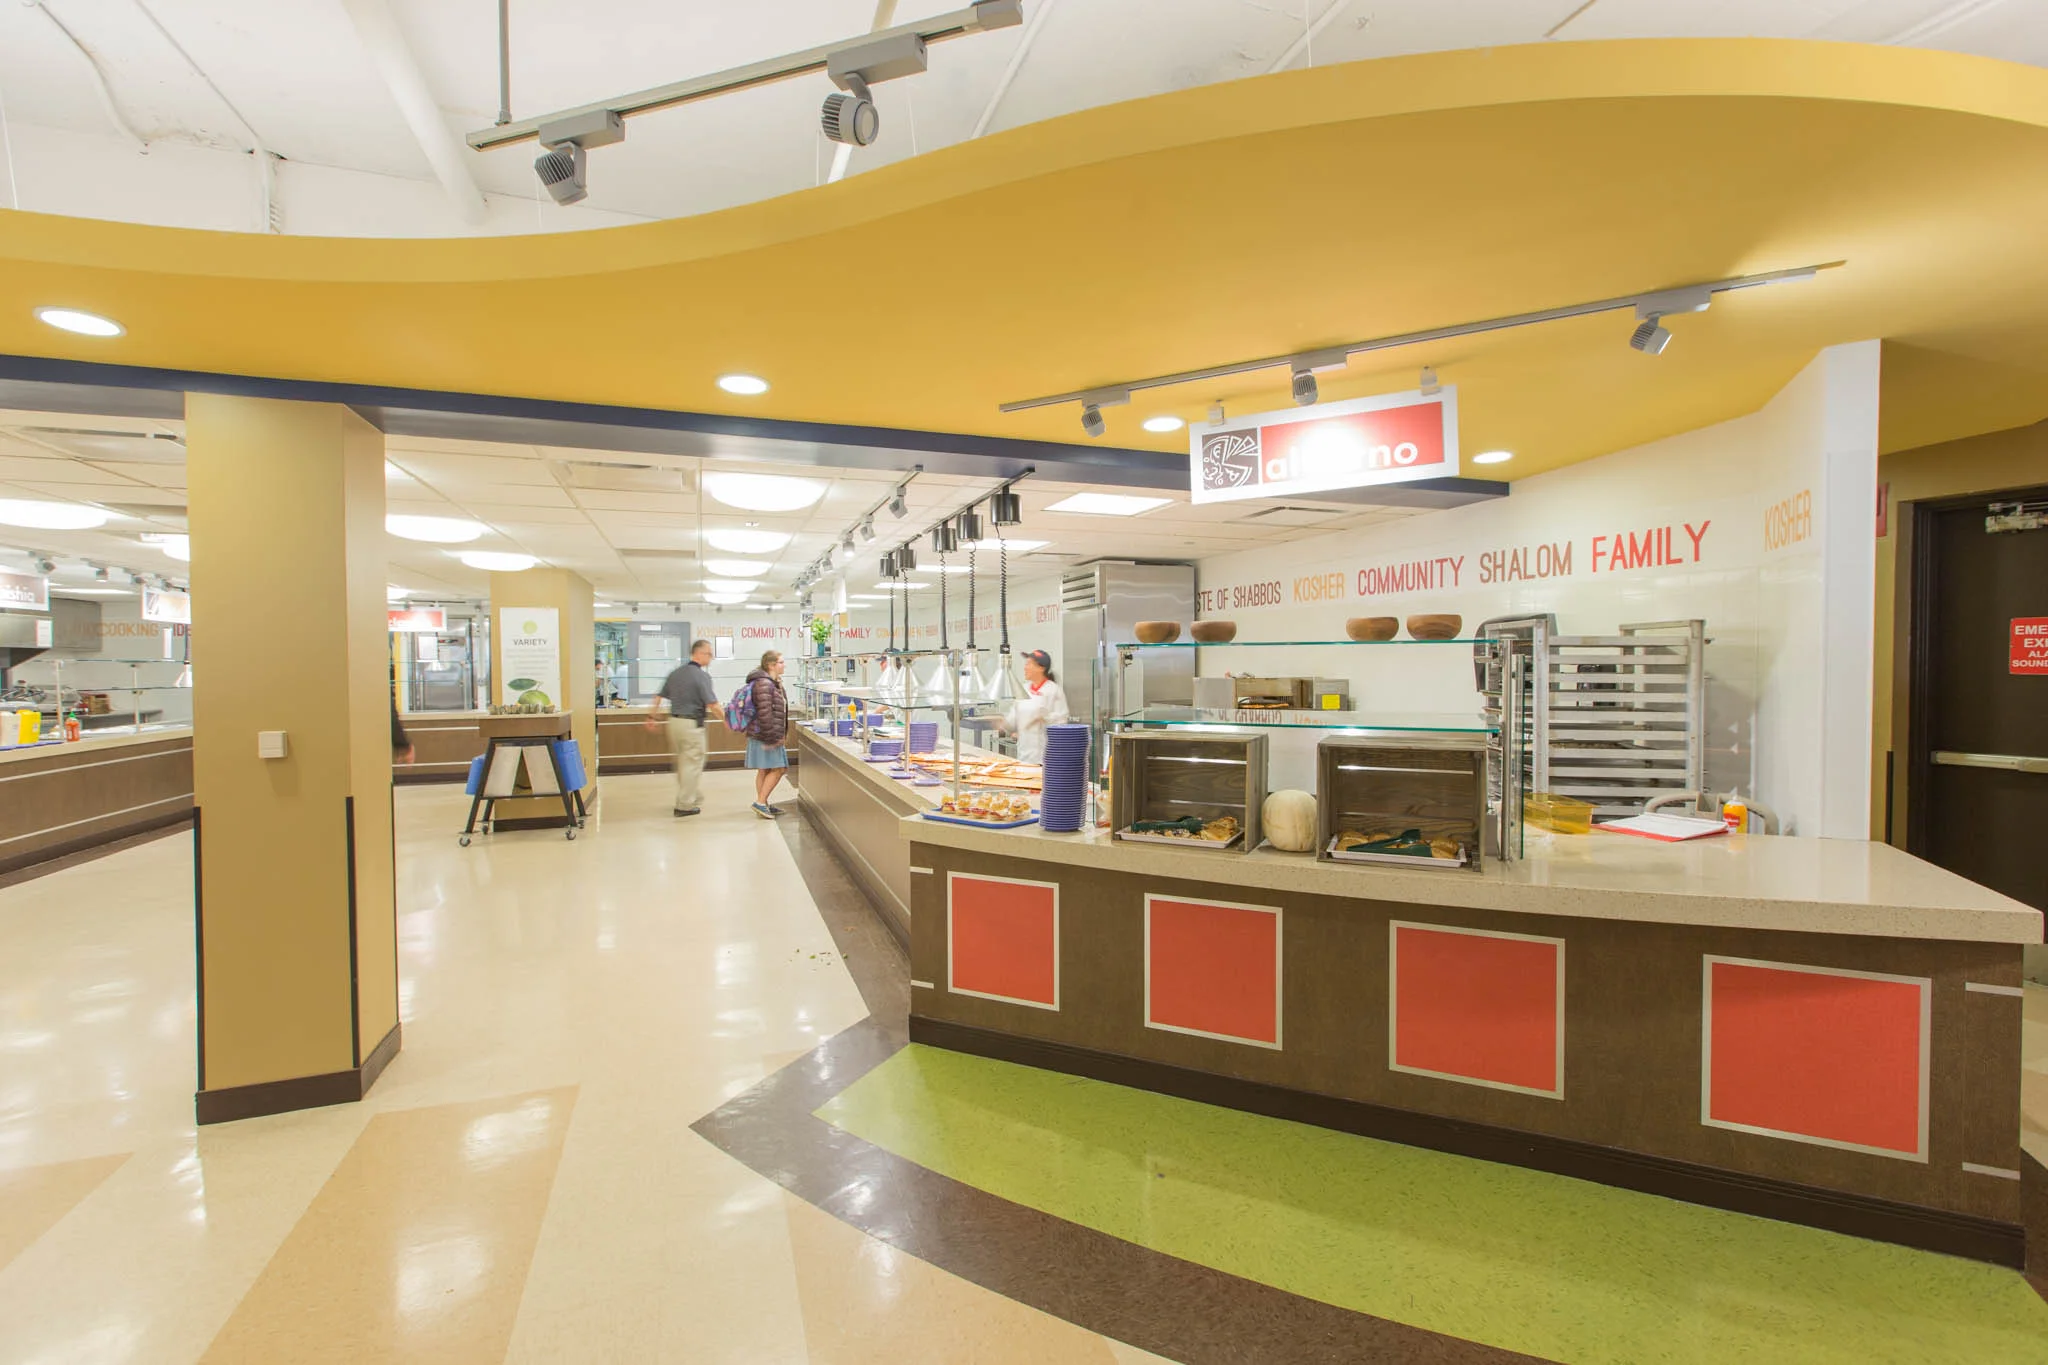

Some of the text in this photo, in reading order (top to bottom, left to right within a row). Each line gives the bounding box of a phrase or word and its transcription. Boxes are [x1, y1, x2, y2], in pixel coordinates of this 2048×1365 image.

[1764, 489, 1812, 552] KOSHER
[1217, 588, 1229, 610] OF
[1233, 581, 1281, 609] SHABBOS
[1293, 572, 1346, 603] KOSHER
[1357, 555, 1465, 597] COMMUNITY
[1479, 541, 1573, 584] SHALOM
[1591, 520, 1711, 573] FAMILY
[513, 638, 548, 647] VARIETY
